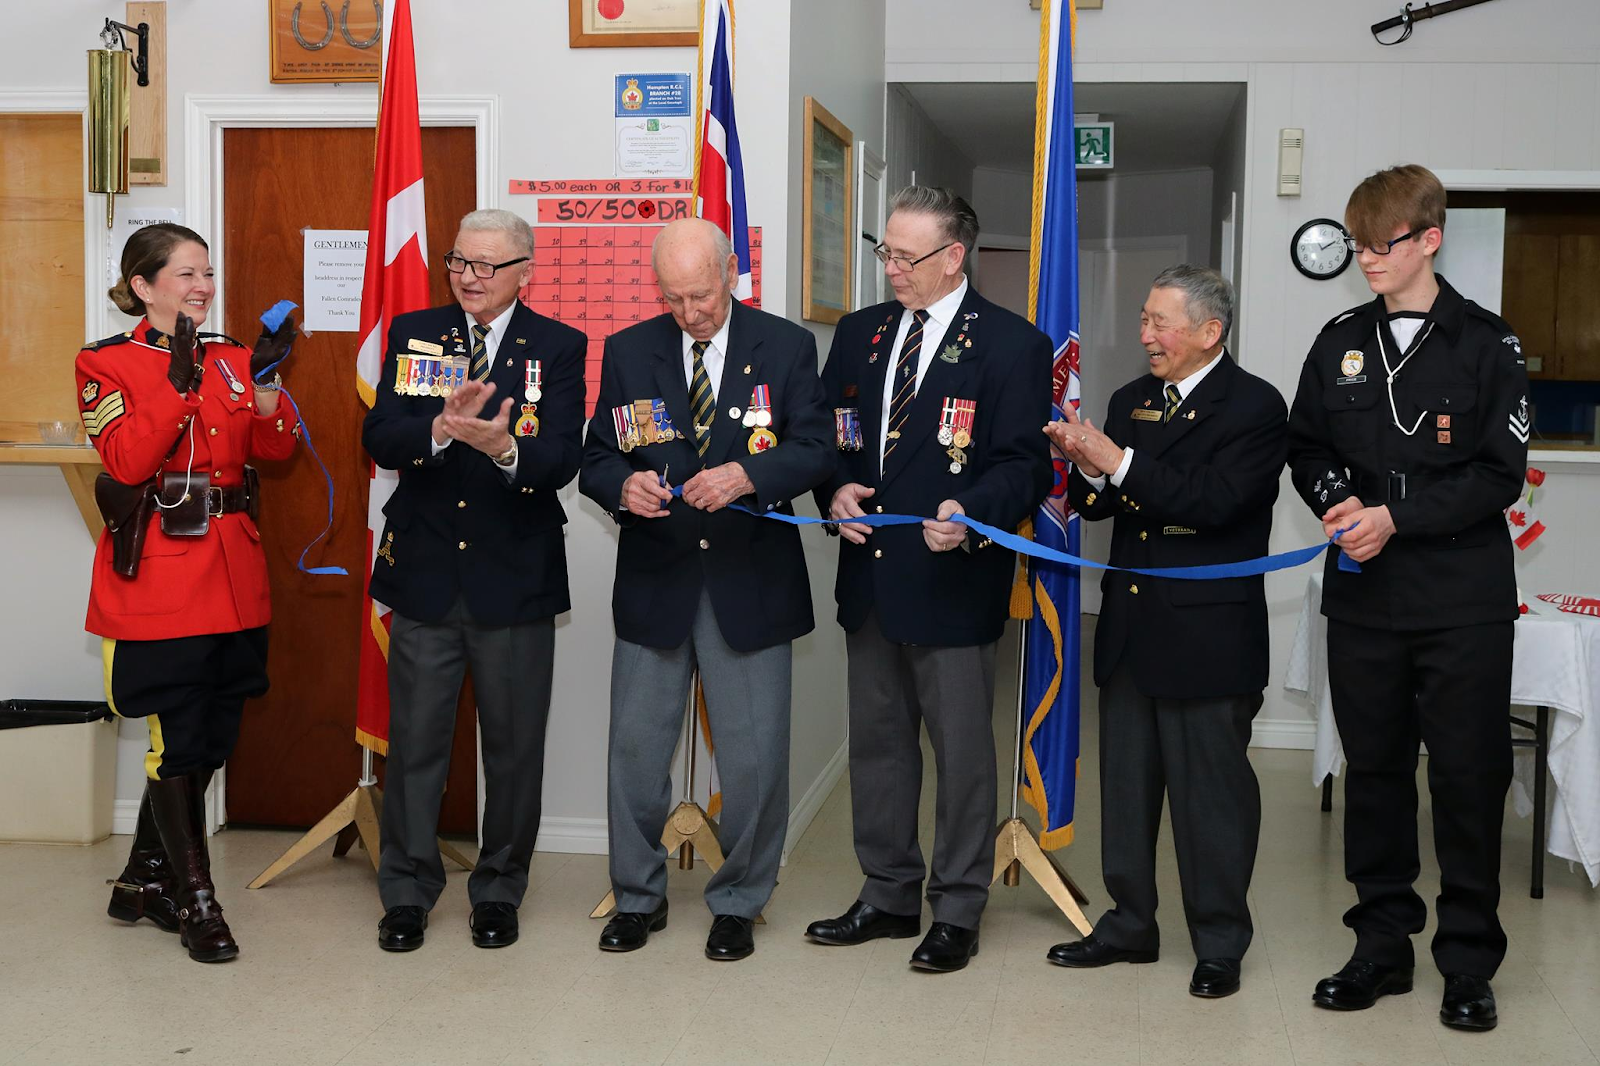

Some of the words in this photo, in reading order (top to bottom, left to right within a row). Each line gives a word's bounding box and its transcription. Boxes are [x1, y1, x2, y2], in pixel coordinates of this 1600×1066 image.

[528, 180, 566, 193] $5.00
[570, 182, 597, 192] each
[605, 182, 621, 192] OR
[630, 181, 642, 192] 3
[556, 199, 636, 220] 50/50
